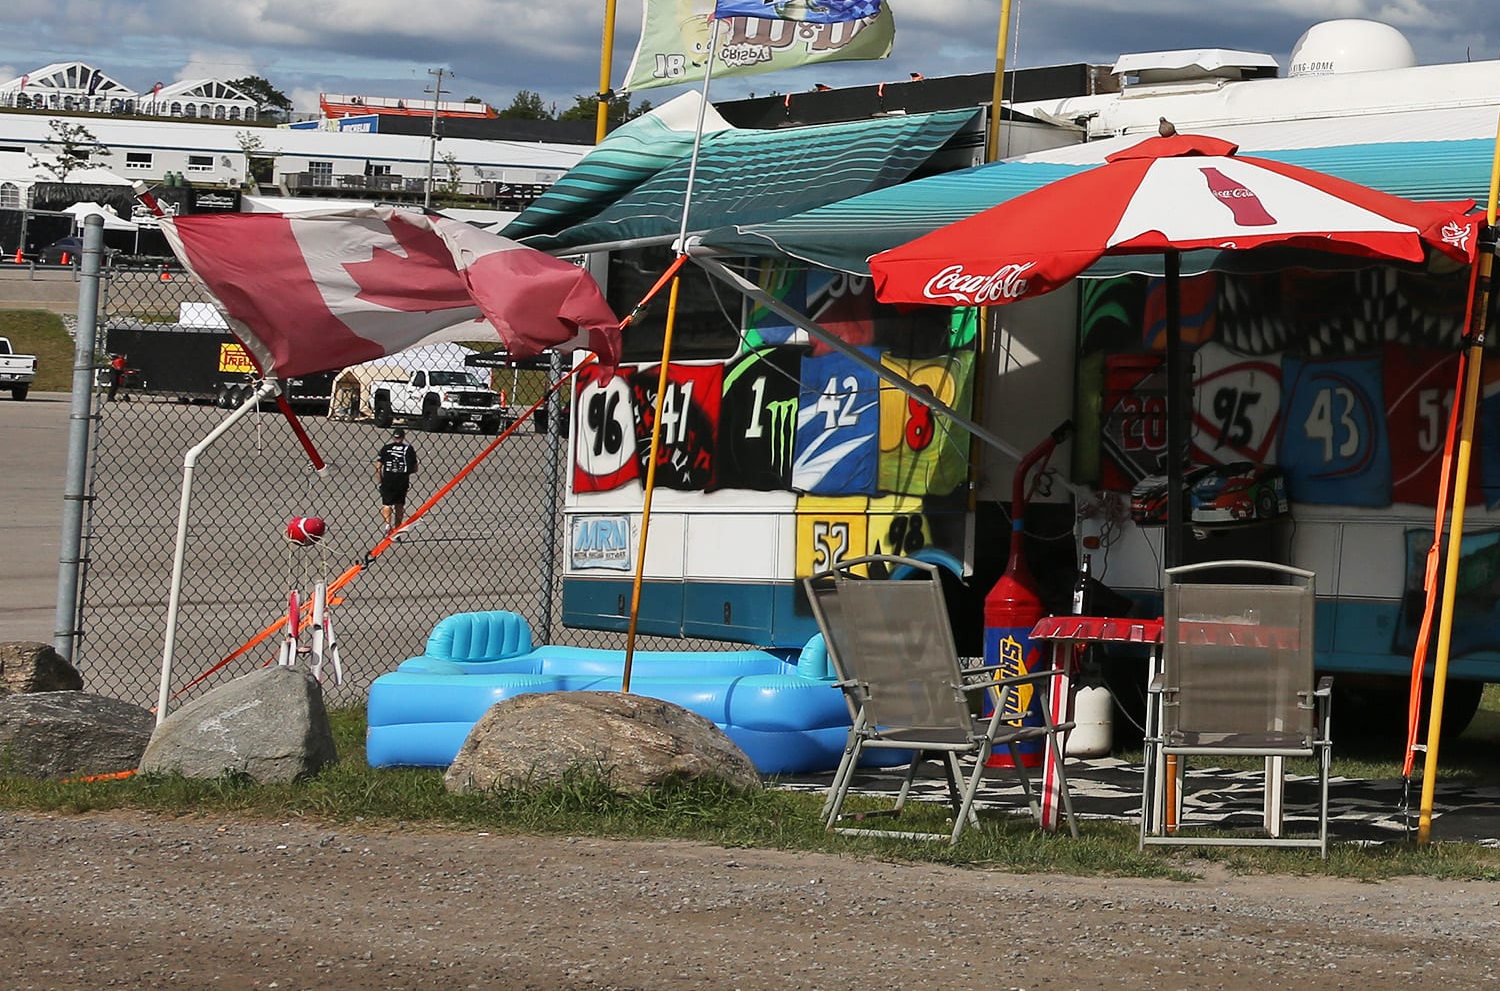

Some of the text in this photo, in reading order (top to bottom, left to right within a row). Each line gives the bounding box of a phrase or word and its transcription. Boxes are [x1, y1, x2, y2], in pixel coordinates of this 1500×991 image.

[922, 260, 1038, 304] Coca-Cola
[587, 389, 623, 457] 96
[660, 377, 694, 445] 41
[744, 375, 766, 439] 1
[816, 375, 860, 430] 42
[1213, 386, 1262, 451] 95
[1303, 386, 1360, 463] 43
[574, 519, 627, 551] MRN
[812, 520, 849, 575] 52
